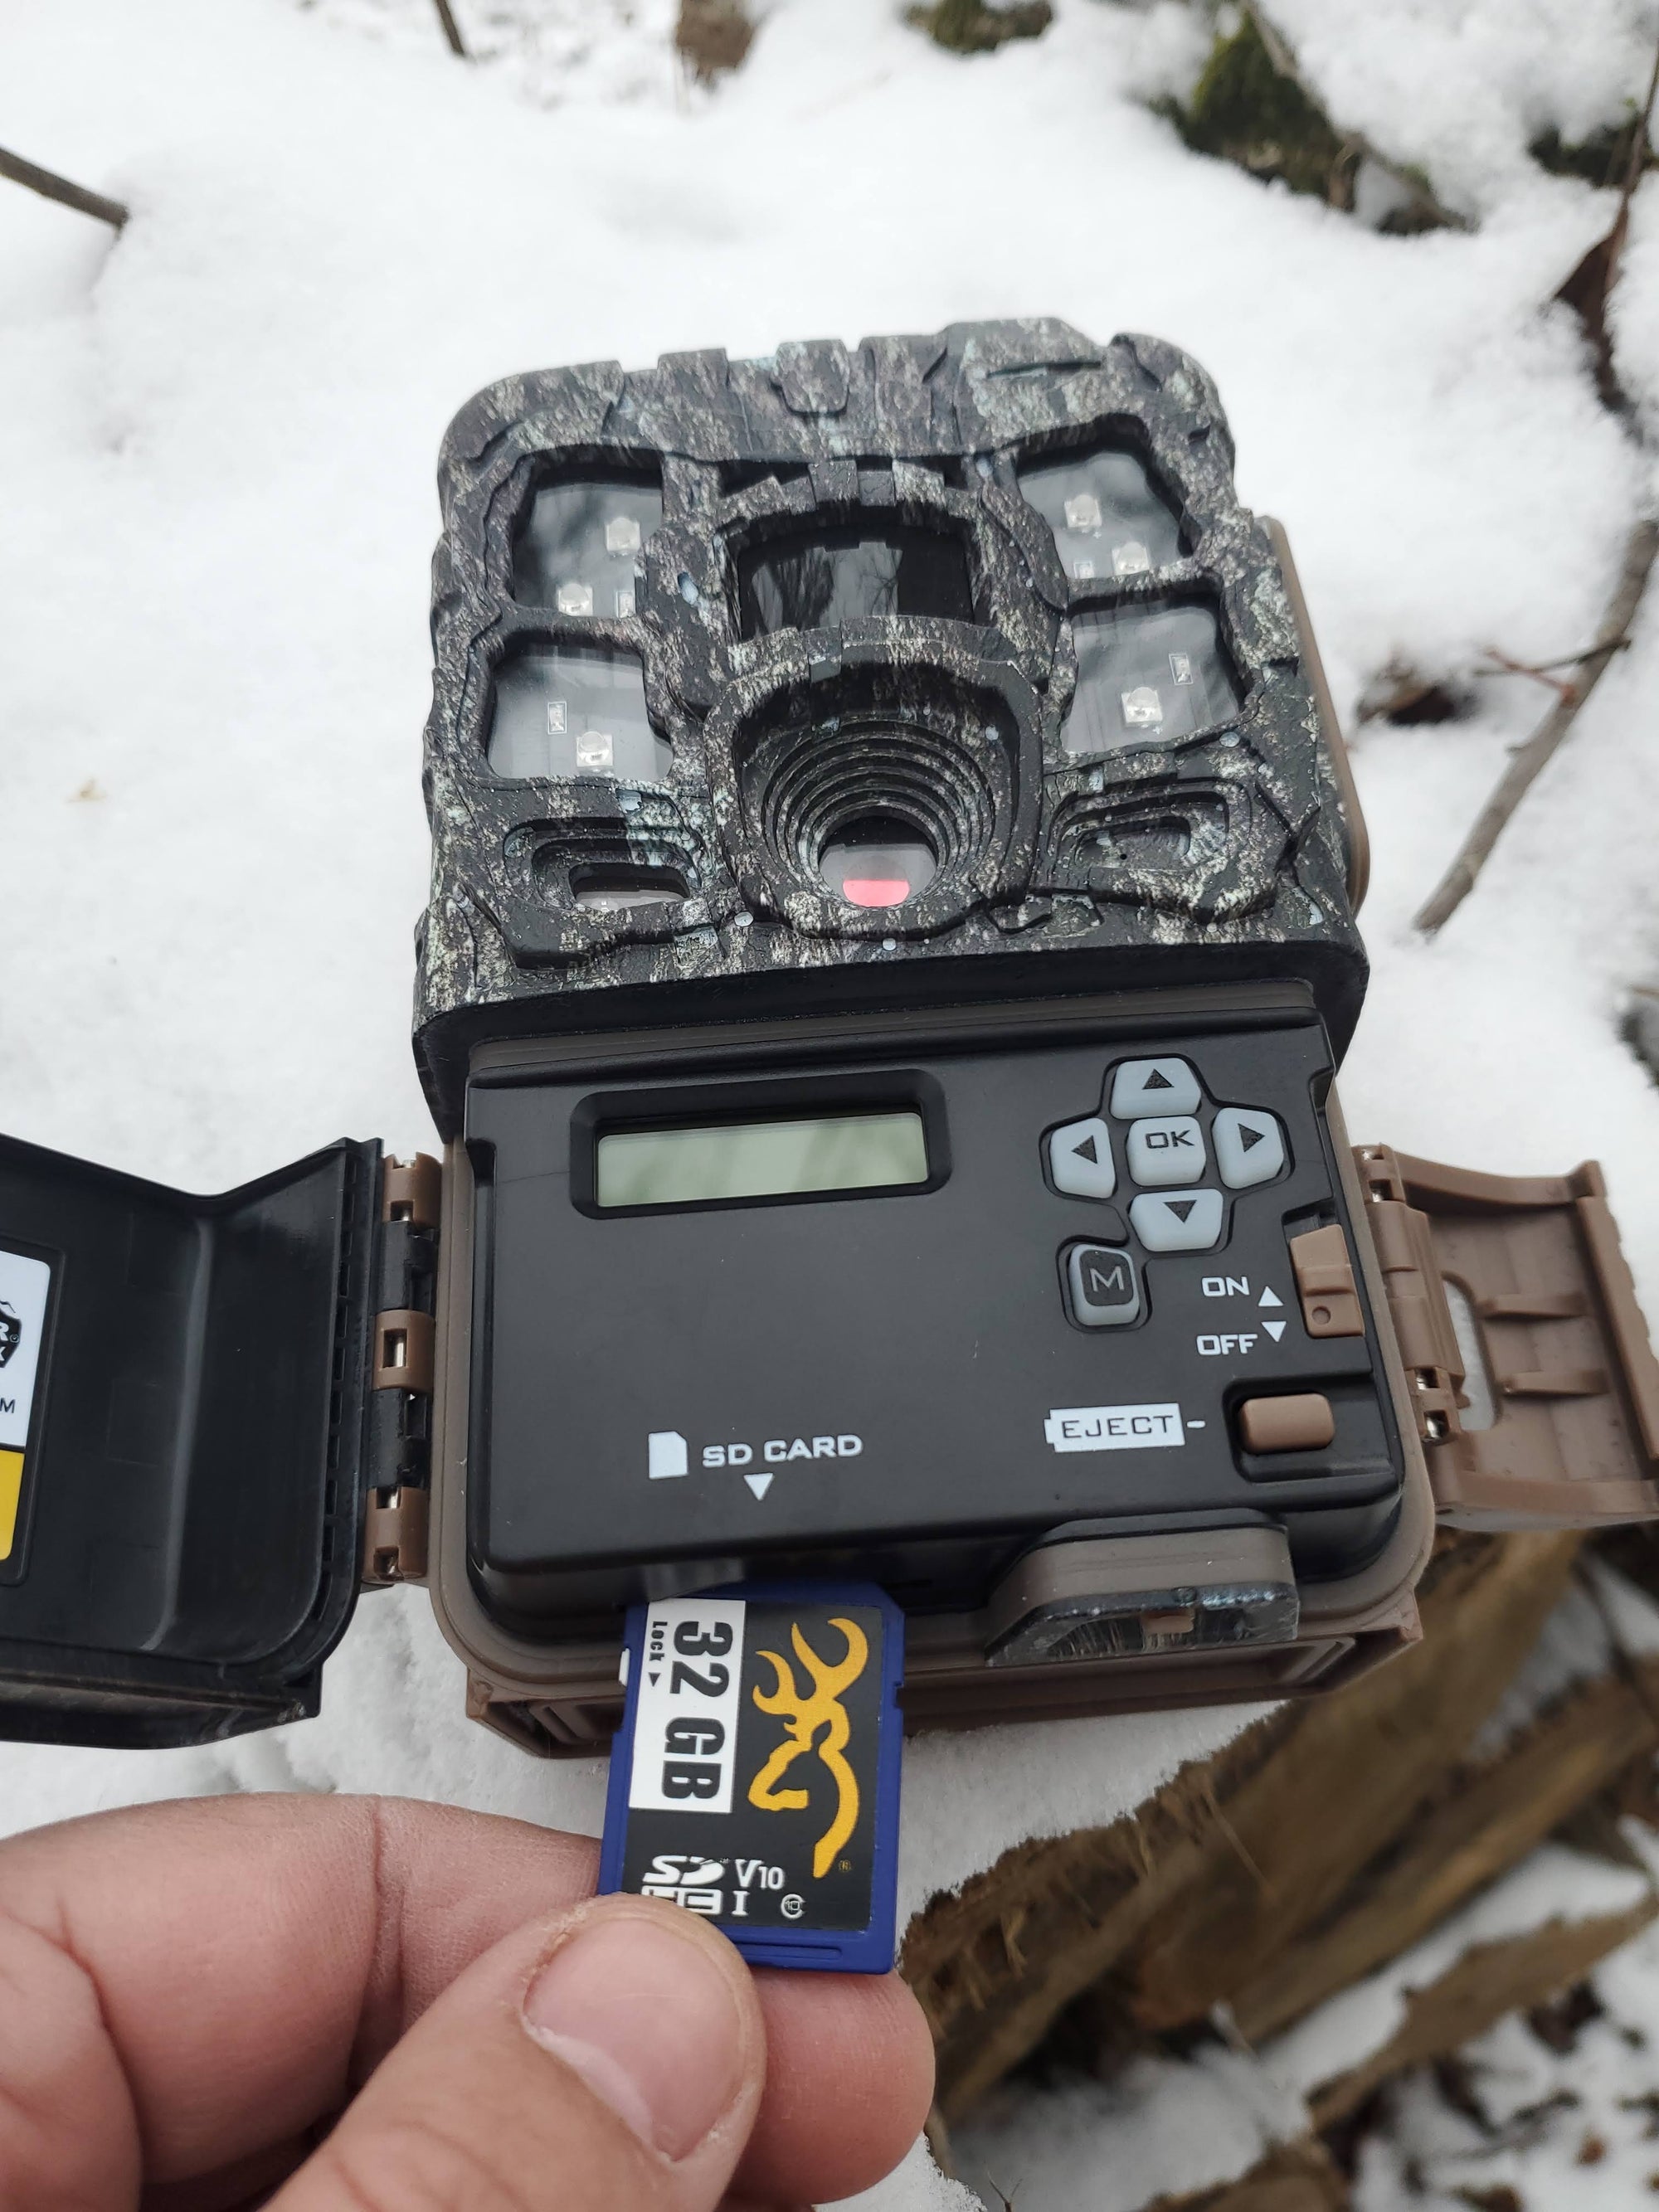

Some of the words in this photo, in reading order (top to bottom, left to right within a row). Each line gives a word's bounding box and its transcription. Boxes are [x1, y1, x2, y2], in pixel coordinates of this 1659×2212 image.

[1145, 1130, 1194, 1150] OK
[1089, 1266, 1125, 1294] M
[1201, 1276, 1250, 1297] ON
[1196, 1333, 1258, 1356] OFF
[1061, 1415, 1174, 1439] EJECT
[703, 1443, 752, 1467] SD
[764, 1434, 863, 1462] CARD
[669, 1621, 733, 1697] 32
[661, 1717, 725, 1799] GB
[735, 1859, 785, 1889] V10
